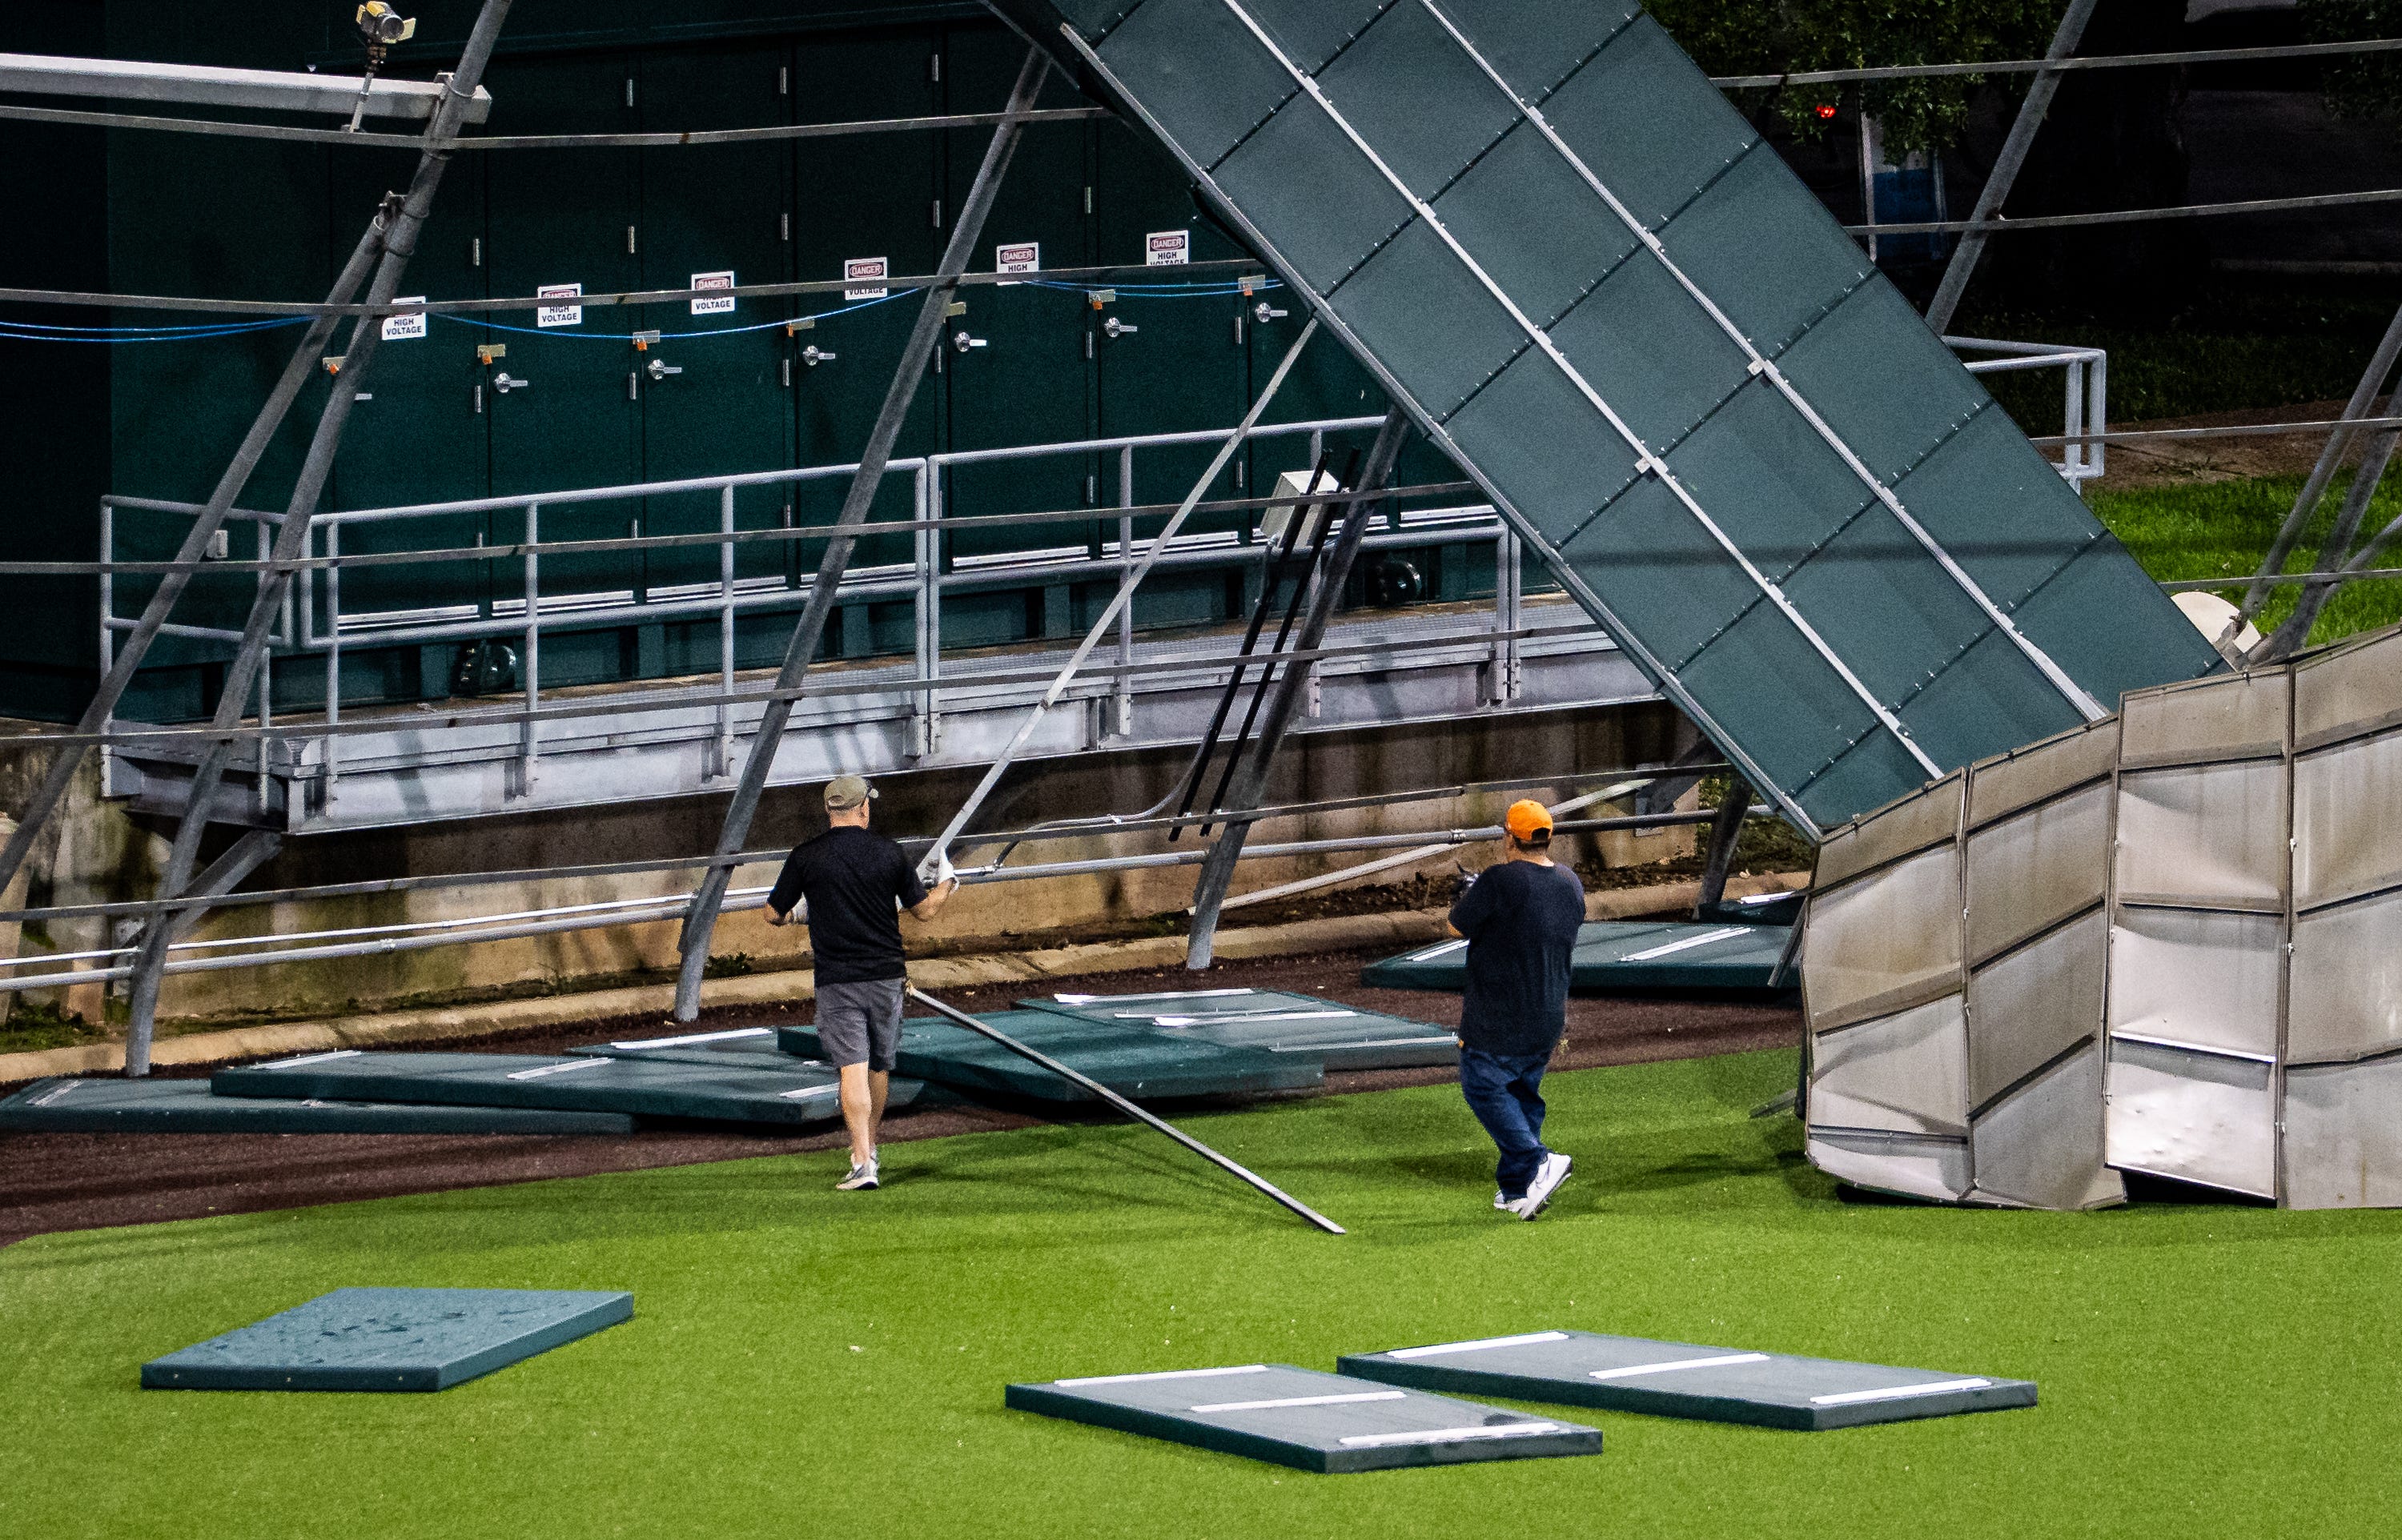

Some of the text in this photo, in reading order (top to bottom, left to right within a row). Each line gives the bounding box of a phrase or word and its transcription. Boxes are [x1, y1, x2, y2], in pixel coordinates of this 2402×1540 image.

[1154, 239, 1182, 249] DANGER
[1004, 251, 1033, 260] DANGER
[1158, 252, 1177, 260] HIGH
[852, 265, 881, 275] DANGER
[699, 279, 728, 289] DANGER
[849, 287, 883, 295] VOLTAGE
[696, 301, 730, 309] VOLTAGE
[542, 313, 577, 322] VOLTAGE
[386, 326, 422, 335] VOLTAGE
